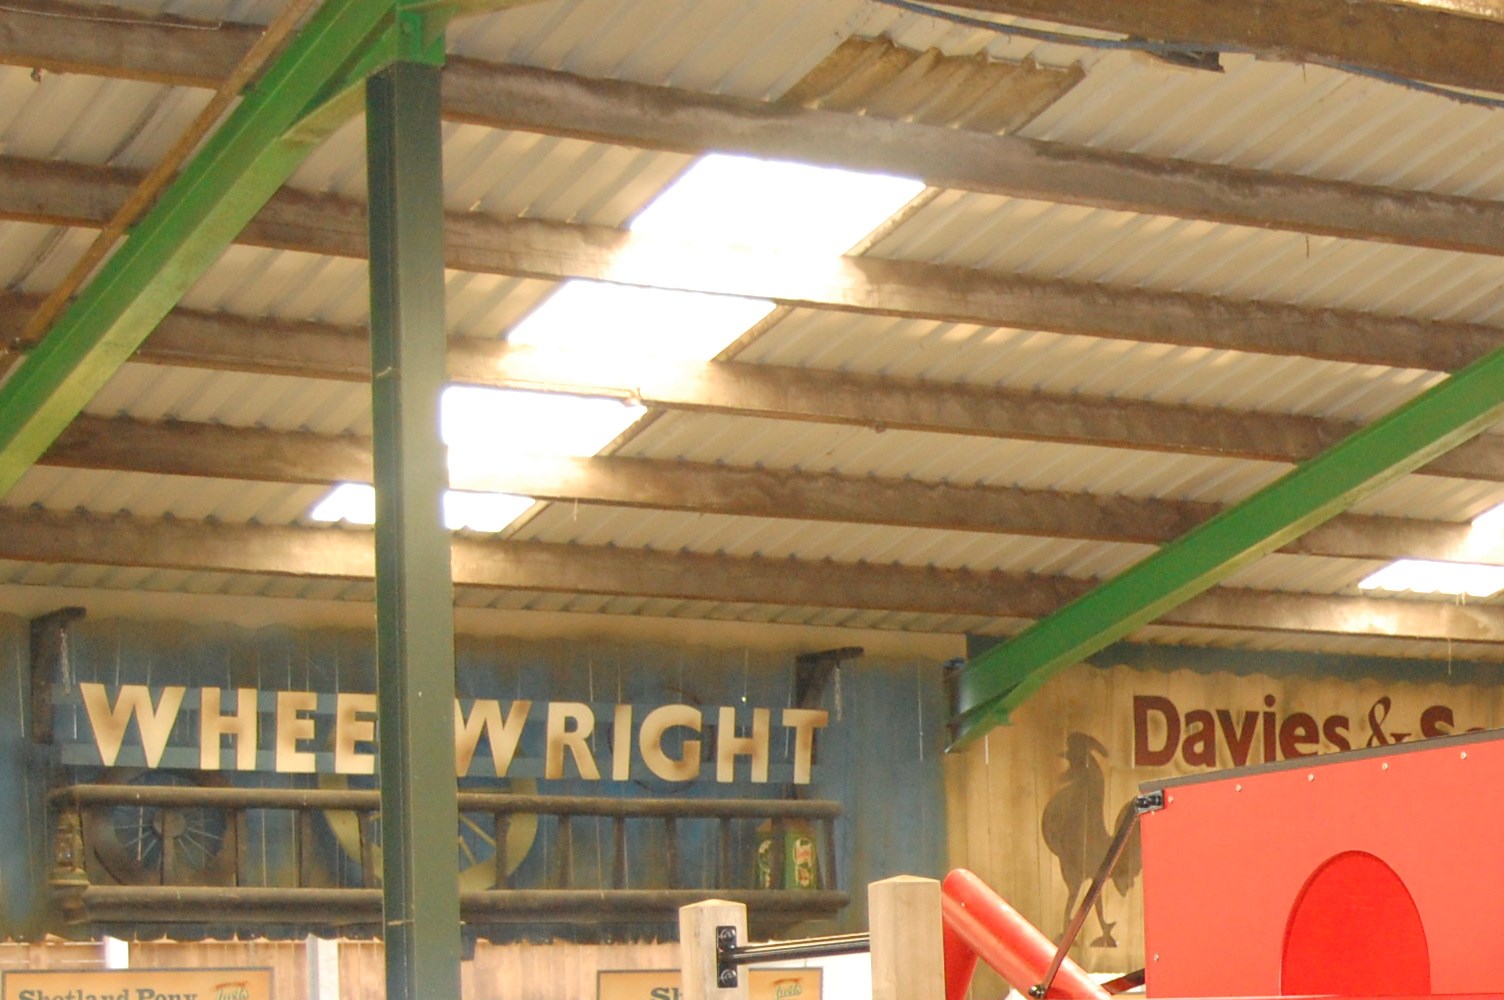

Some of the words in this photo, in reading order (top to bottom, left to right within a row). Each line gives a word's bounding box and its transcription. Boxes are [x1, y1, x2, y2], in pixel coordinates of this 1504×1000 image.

[80, 682, 828, 784] WHEEWRIGHT
[1132, 694, 1351, 768] Davies
[1366, 695, 1412, 748] &
